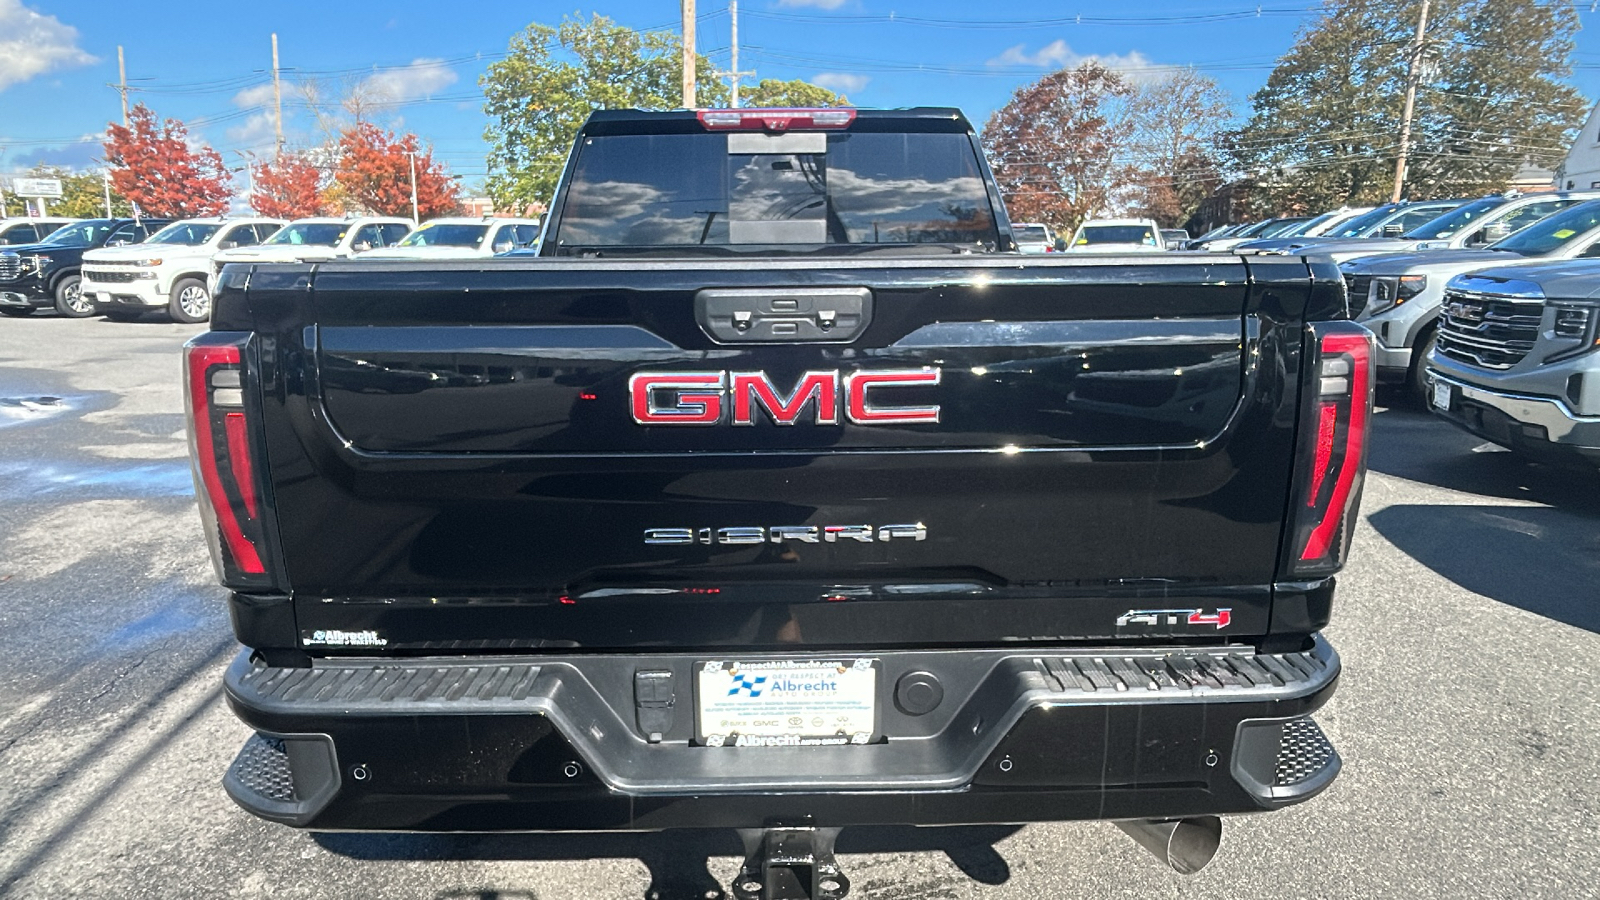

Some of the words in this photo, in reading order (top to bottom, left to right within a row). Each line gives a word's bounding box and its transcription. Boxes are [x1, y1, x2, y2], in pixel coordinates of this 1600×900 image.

[628, 366, 942, 427] GMC
[643, 521, 928, 545] SIERRA
[1115, 607, 1233, 630] AT4
[325, 630, 378, 641] Albrecht
[770, 680, 837, 692] Albrecht
[735, 734, 801, 746] Albrecht
